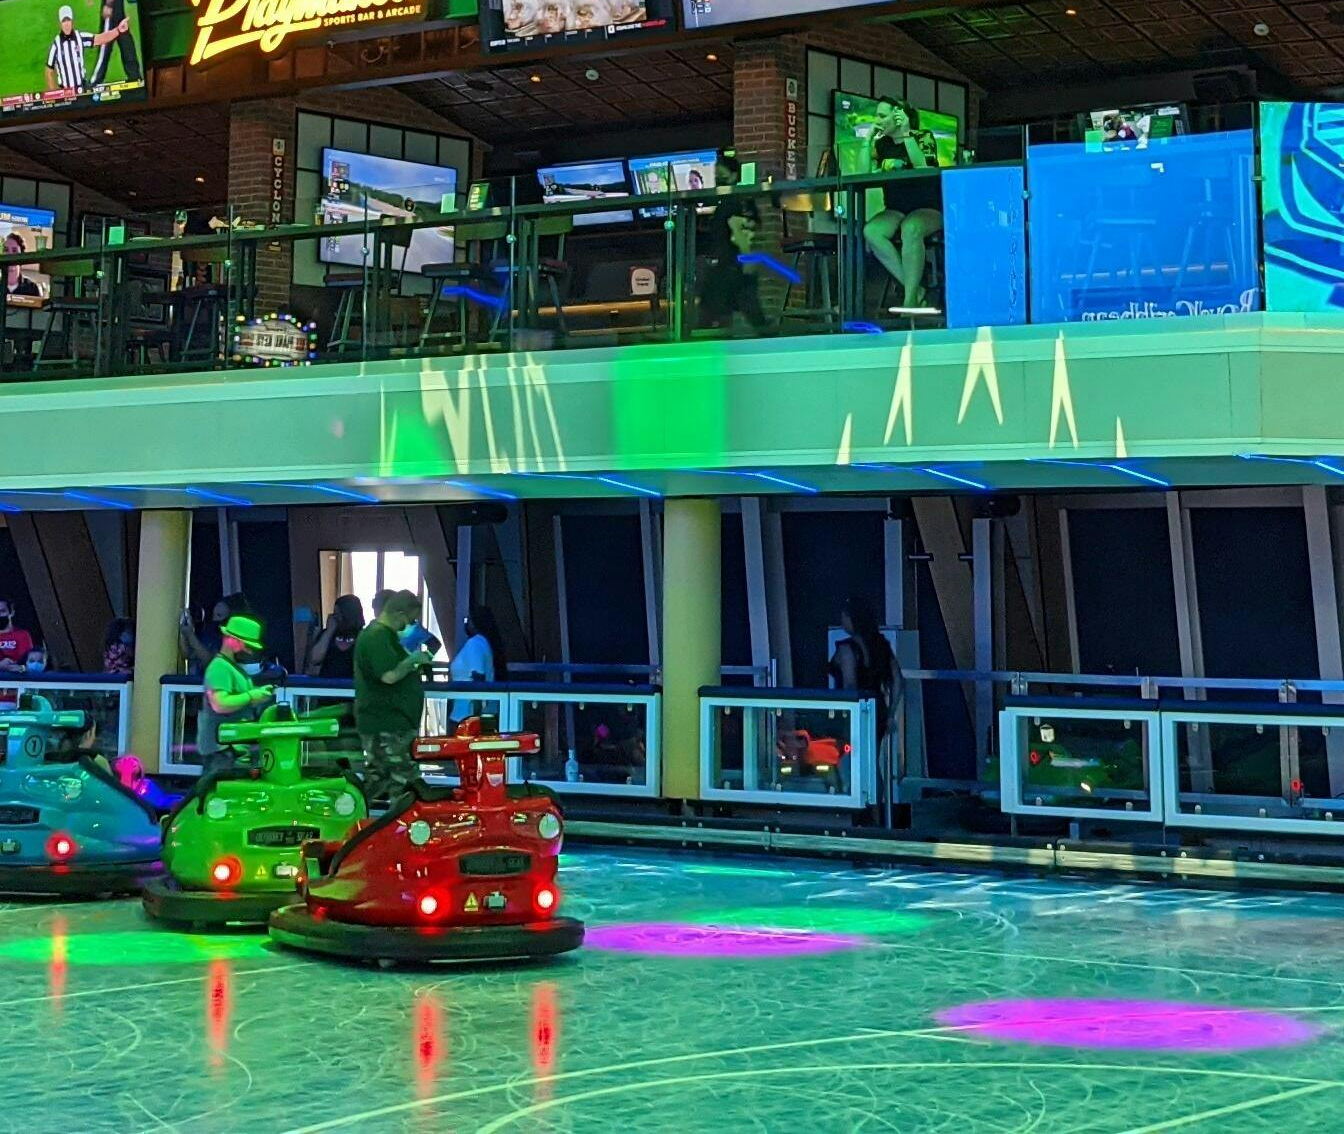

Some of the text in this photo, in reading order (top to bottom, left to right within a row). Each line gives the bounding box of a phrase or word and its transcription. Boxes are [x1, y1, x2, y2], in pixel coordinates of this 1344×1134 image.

[323, 14, 356, 26] SPORTS
[357, 11, 375, 22] BAR
[385, 4, 422, 18] ARCADE
[786, 102, 798, 180] BUCKEY
[271, 156, 284, 226] CYCLON
